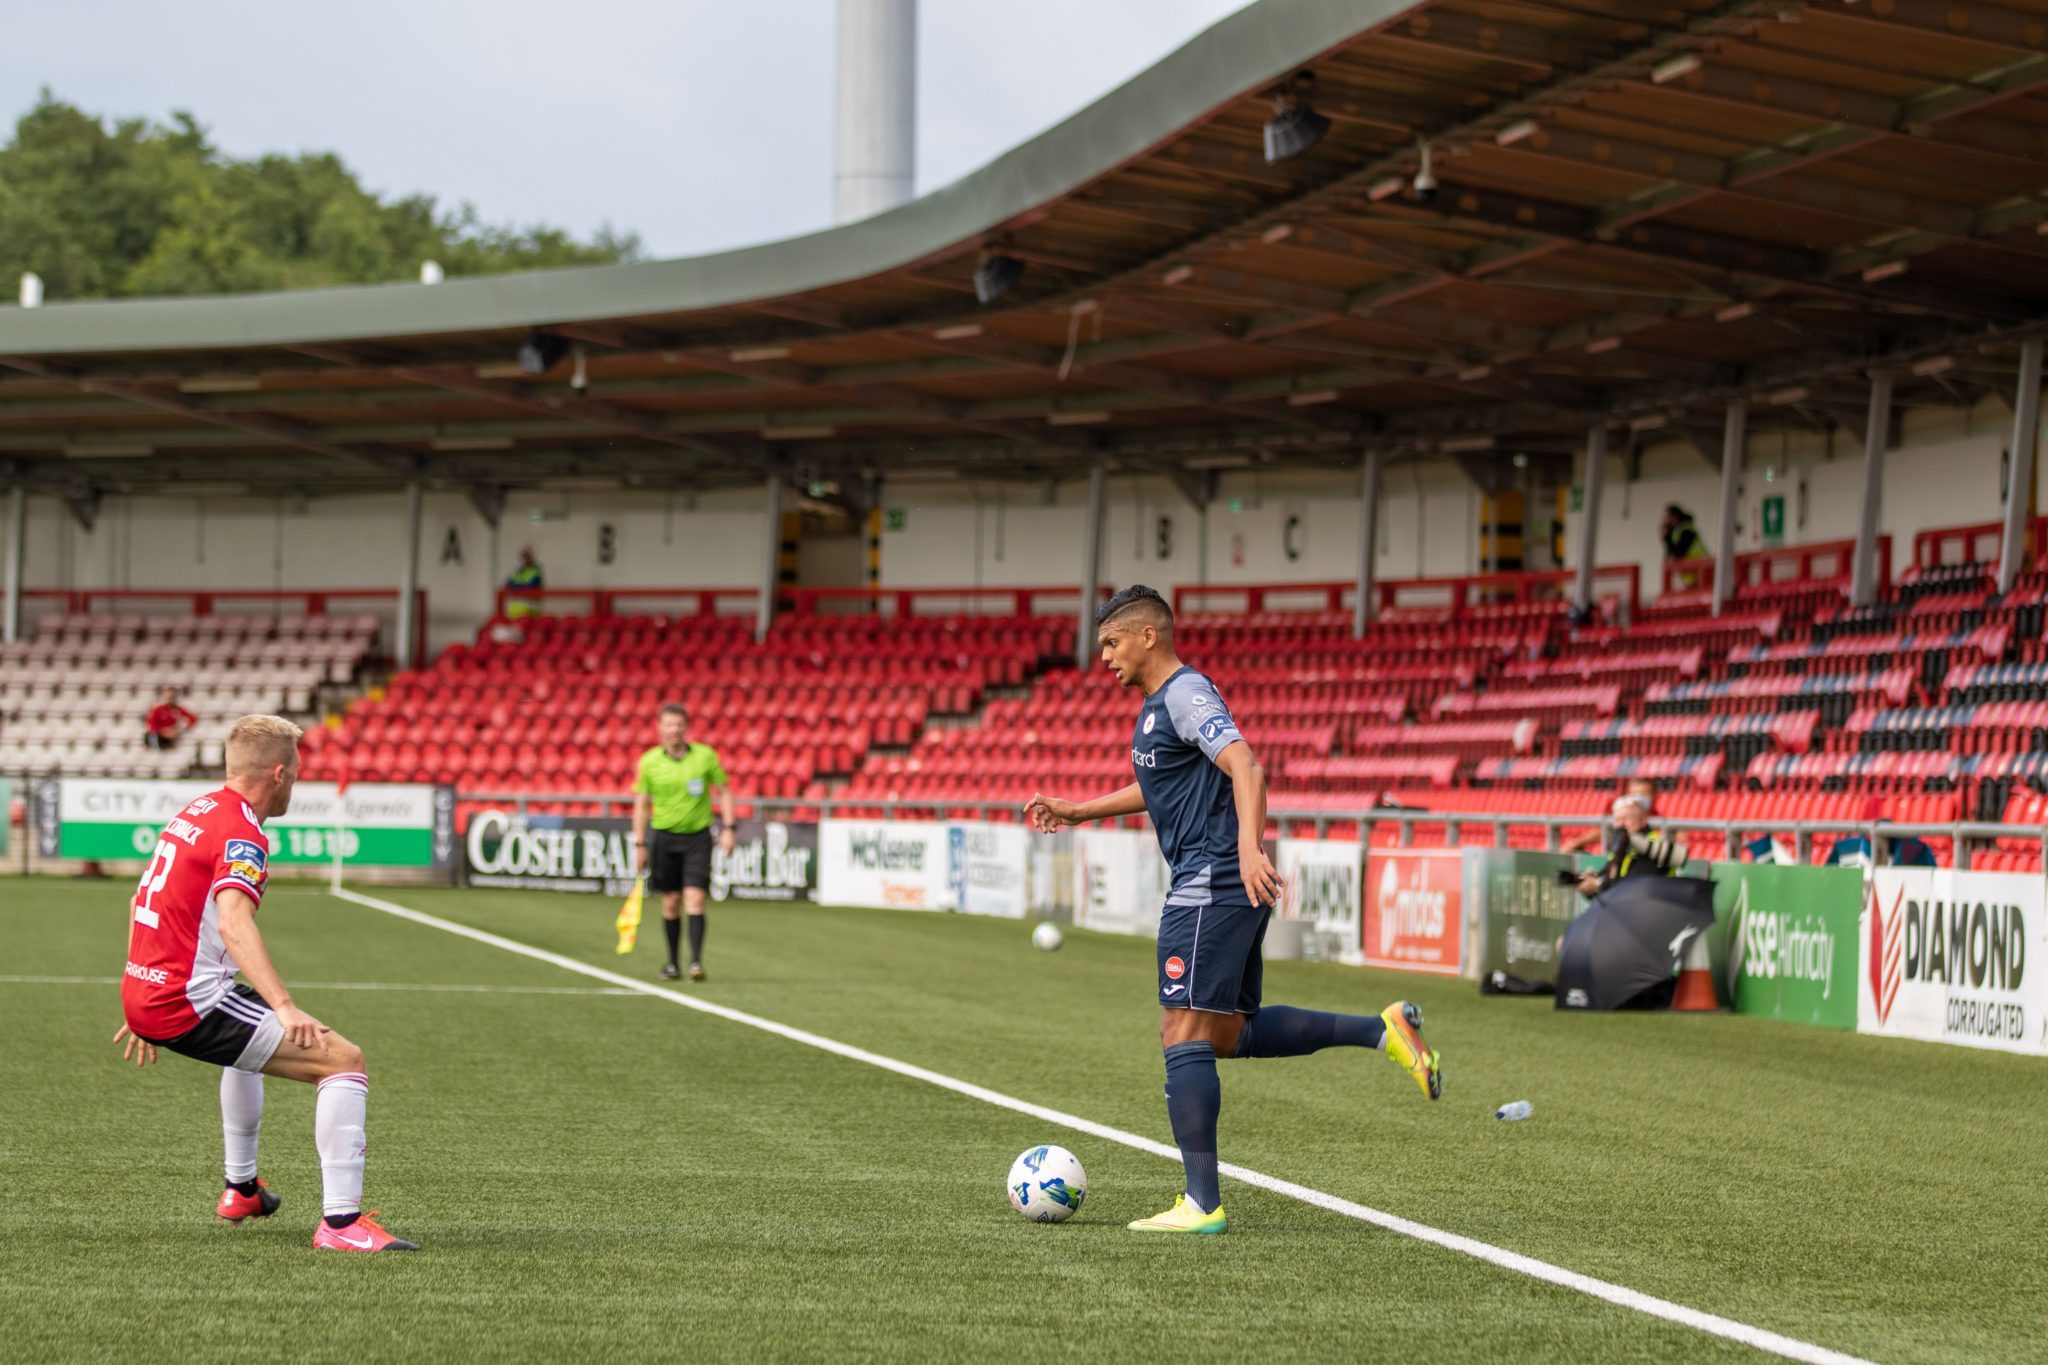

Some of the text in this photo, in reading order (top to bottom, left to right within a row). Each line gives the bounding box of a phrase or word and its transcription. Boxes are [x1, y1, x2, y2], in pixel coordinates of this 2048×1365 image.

[440, 527, 463, 567] A
[82, 788, 148, 813] CITY
[466, 809, 579, 877] COSH
[1905, 900, 2025, 992] DIAMOND
[1946, 996, 2024, 1041] CORRUGATED
